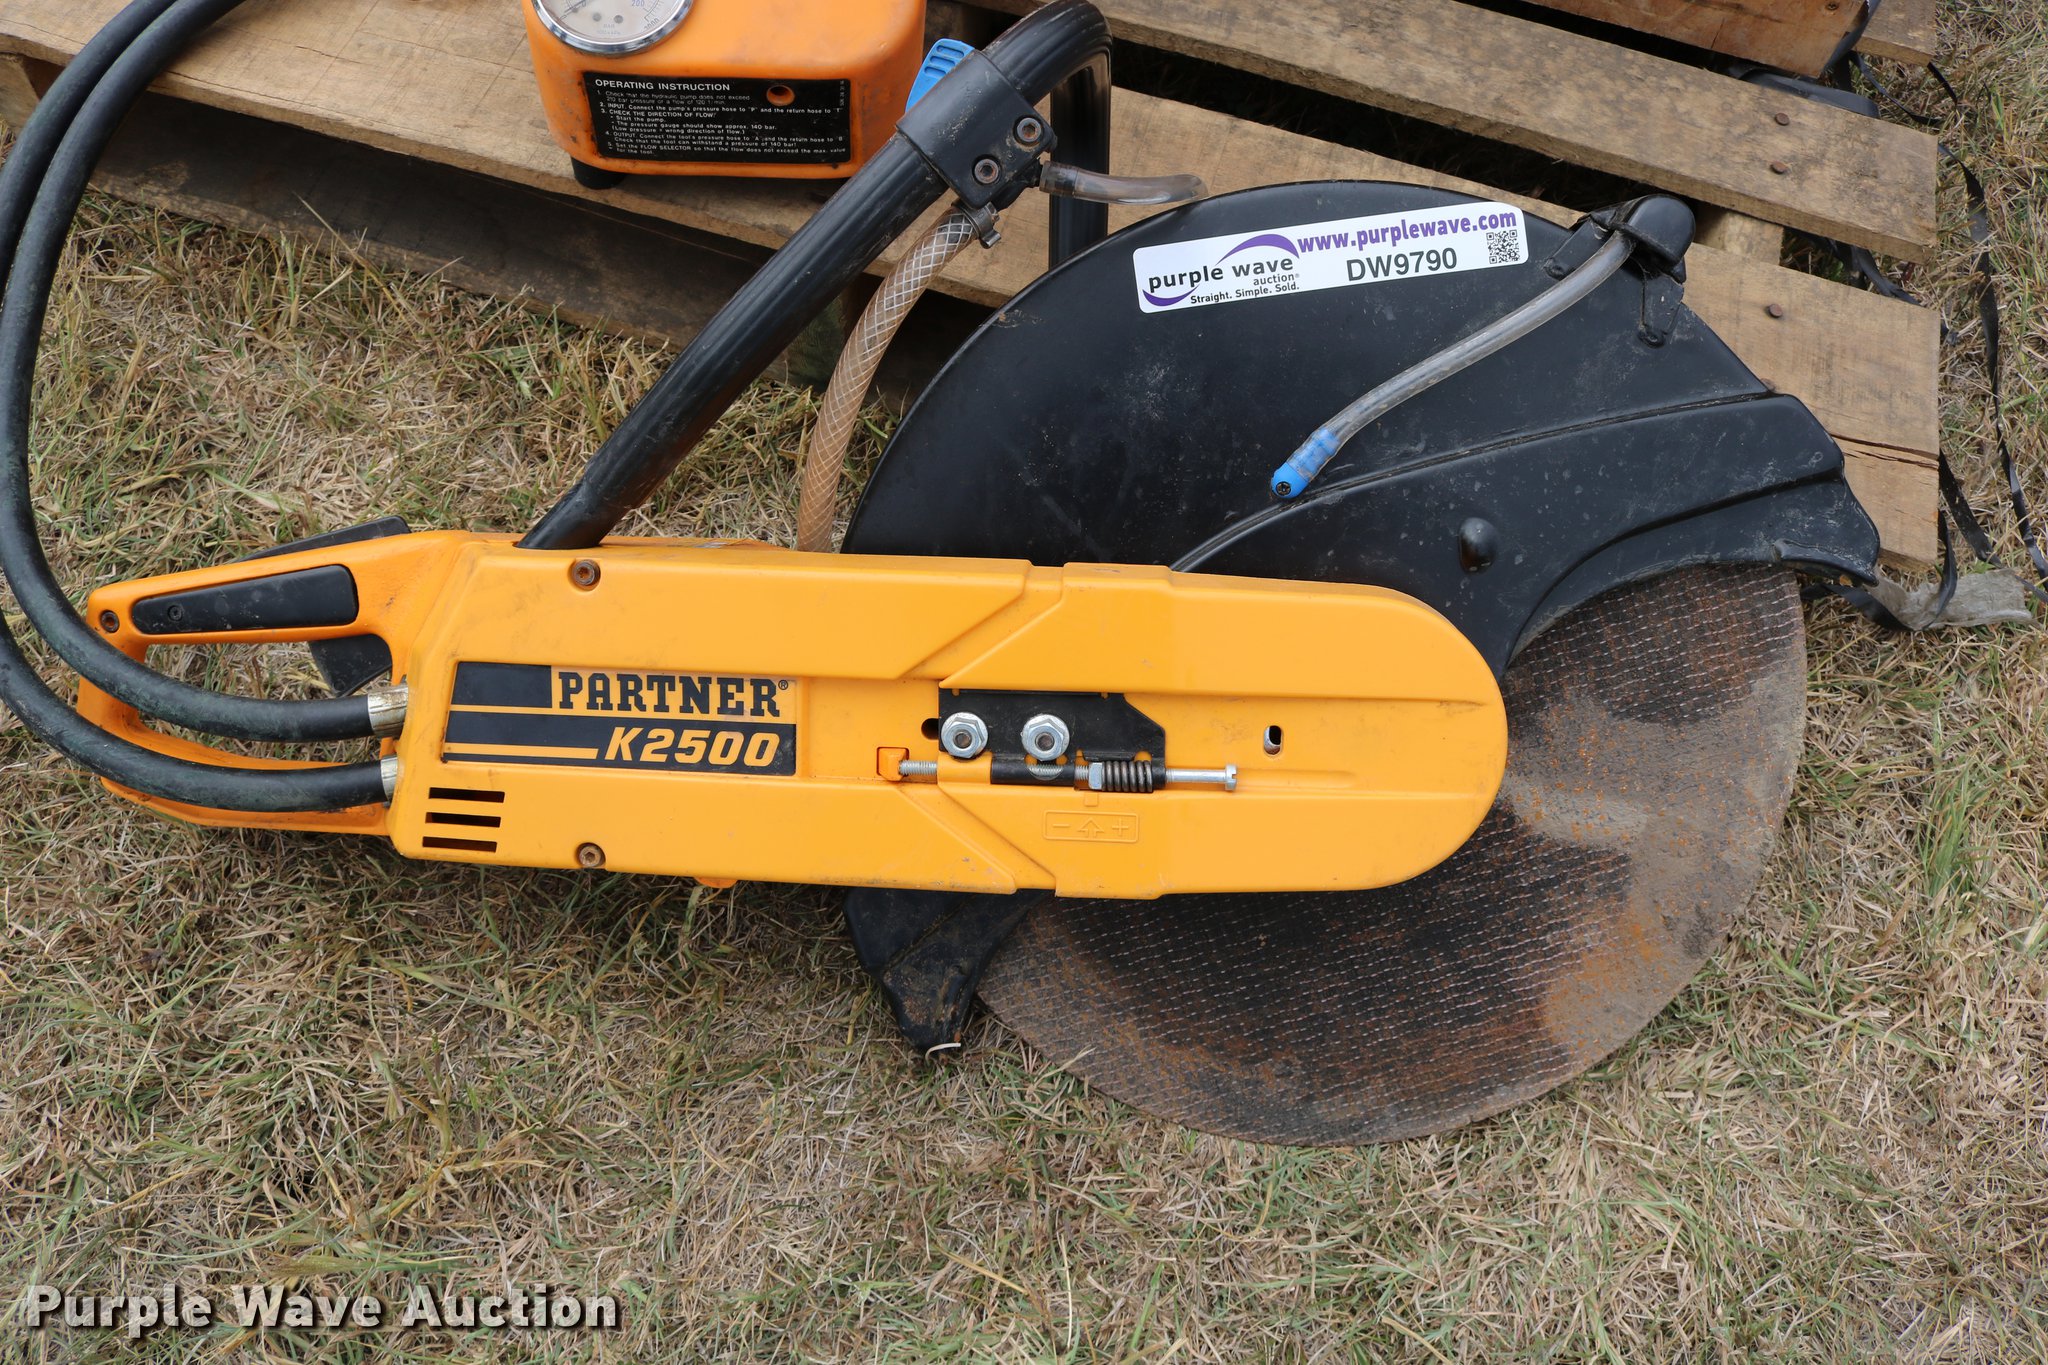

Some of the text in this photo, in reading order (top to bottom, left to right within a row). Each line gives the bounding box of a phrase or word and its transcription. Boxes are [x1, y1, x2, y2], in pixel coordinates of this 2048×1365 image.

[595, 79, 730, 91] OPERATING INSTRUCTION
[1298, 210, 1518, 253] www.purplewave.com
[1148, 257, 1294, 293] purple wave
[1346, 247, 1458, 282] DW9790
[1190, 282, 1300, 305] Straight. Simple. Sold.
[604, 726, 781, 767] K2500
